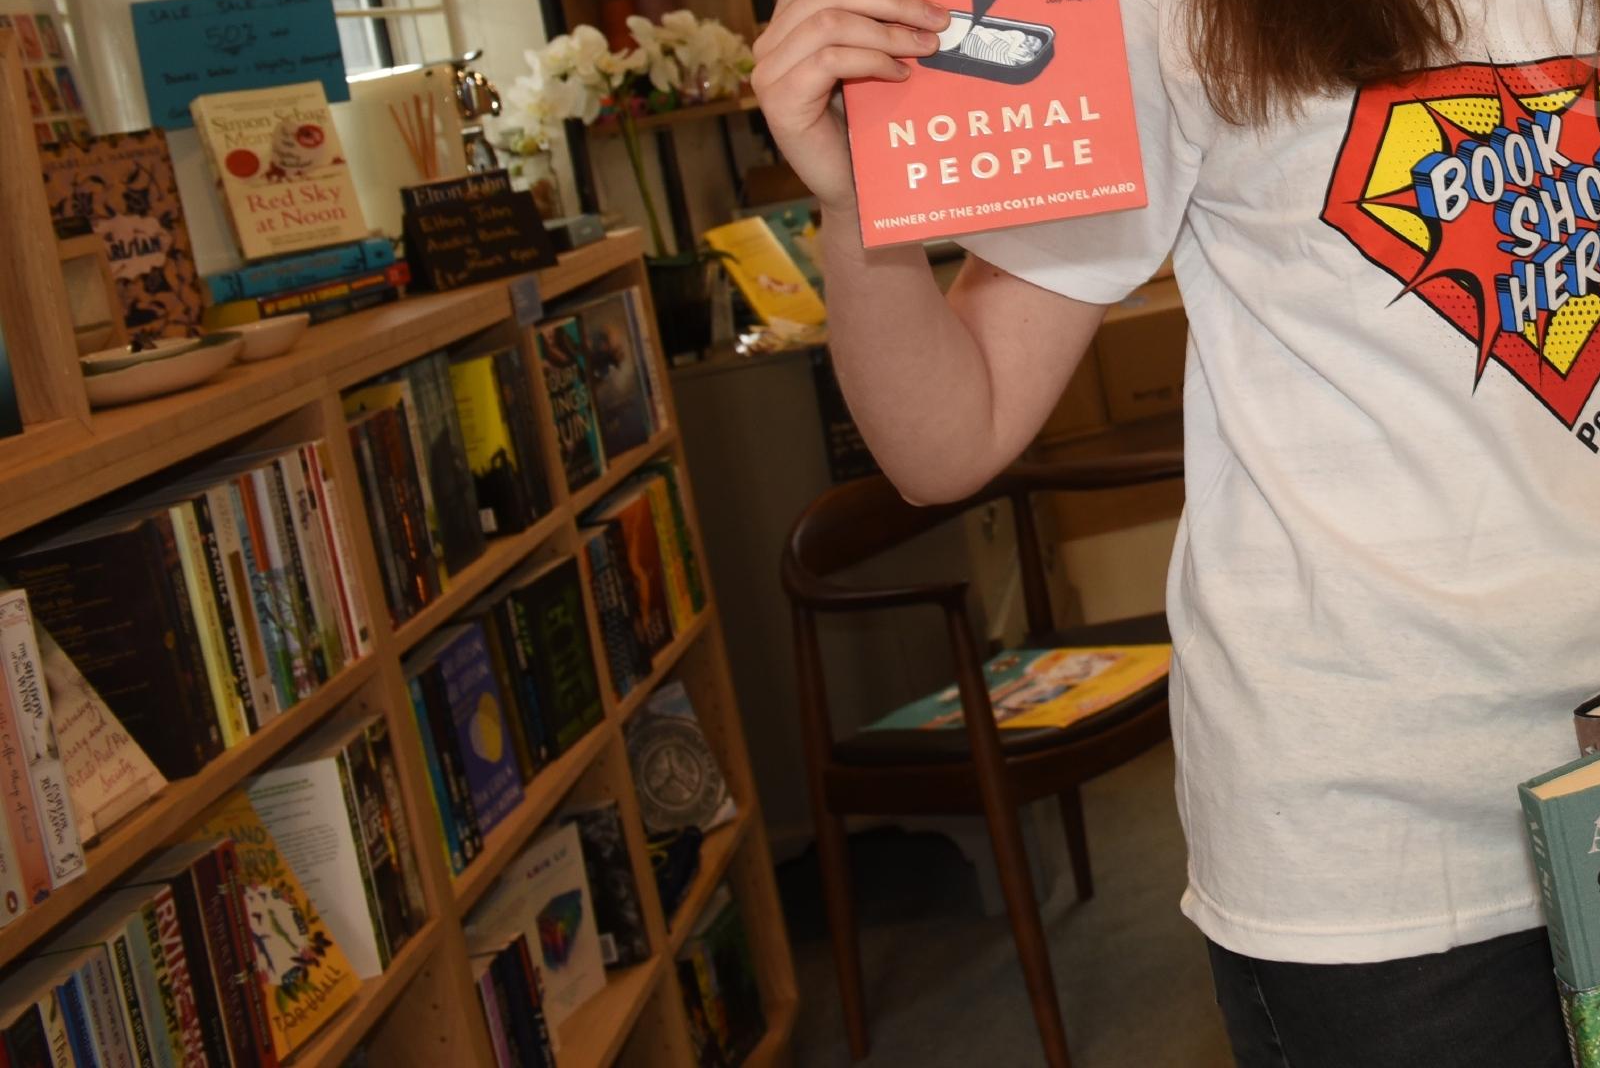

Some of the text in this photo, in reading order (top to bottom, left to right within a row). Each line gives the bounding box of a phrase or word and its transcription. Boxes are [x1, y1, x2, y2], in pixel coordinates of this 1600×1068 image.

[150, 5, 192, 25] SALE
[888, 96, 1101, 149] NORMAL
[907, 138, 1093, 190] PEOPLE
[1410, 110, 1573, 222] BOOK
[247, 184, 342, 213] Red Sky
[256, 206, 348, 233] at Noon
[874, 181, 1137, 231] WINNER OF THE 2018 COSTA NOVEL AWARD
